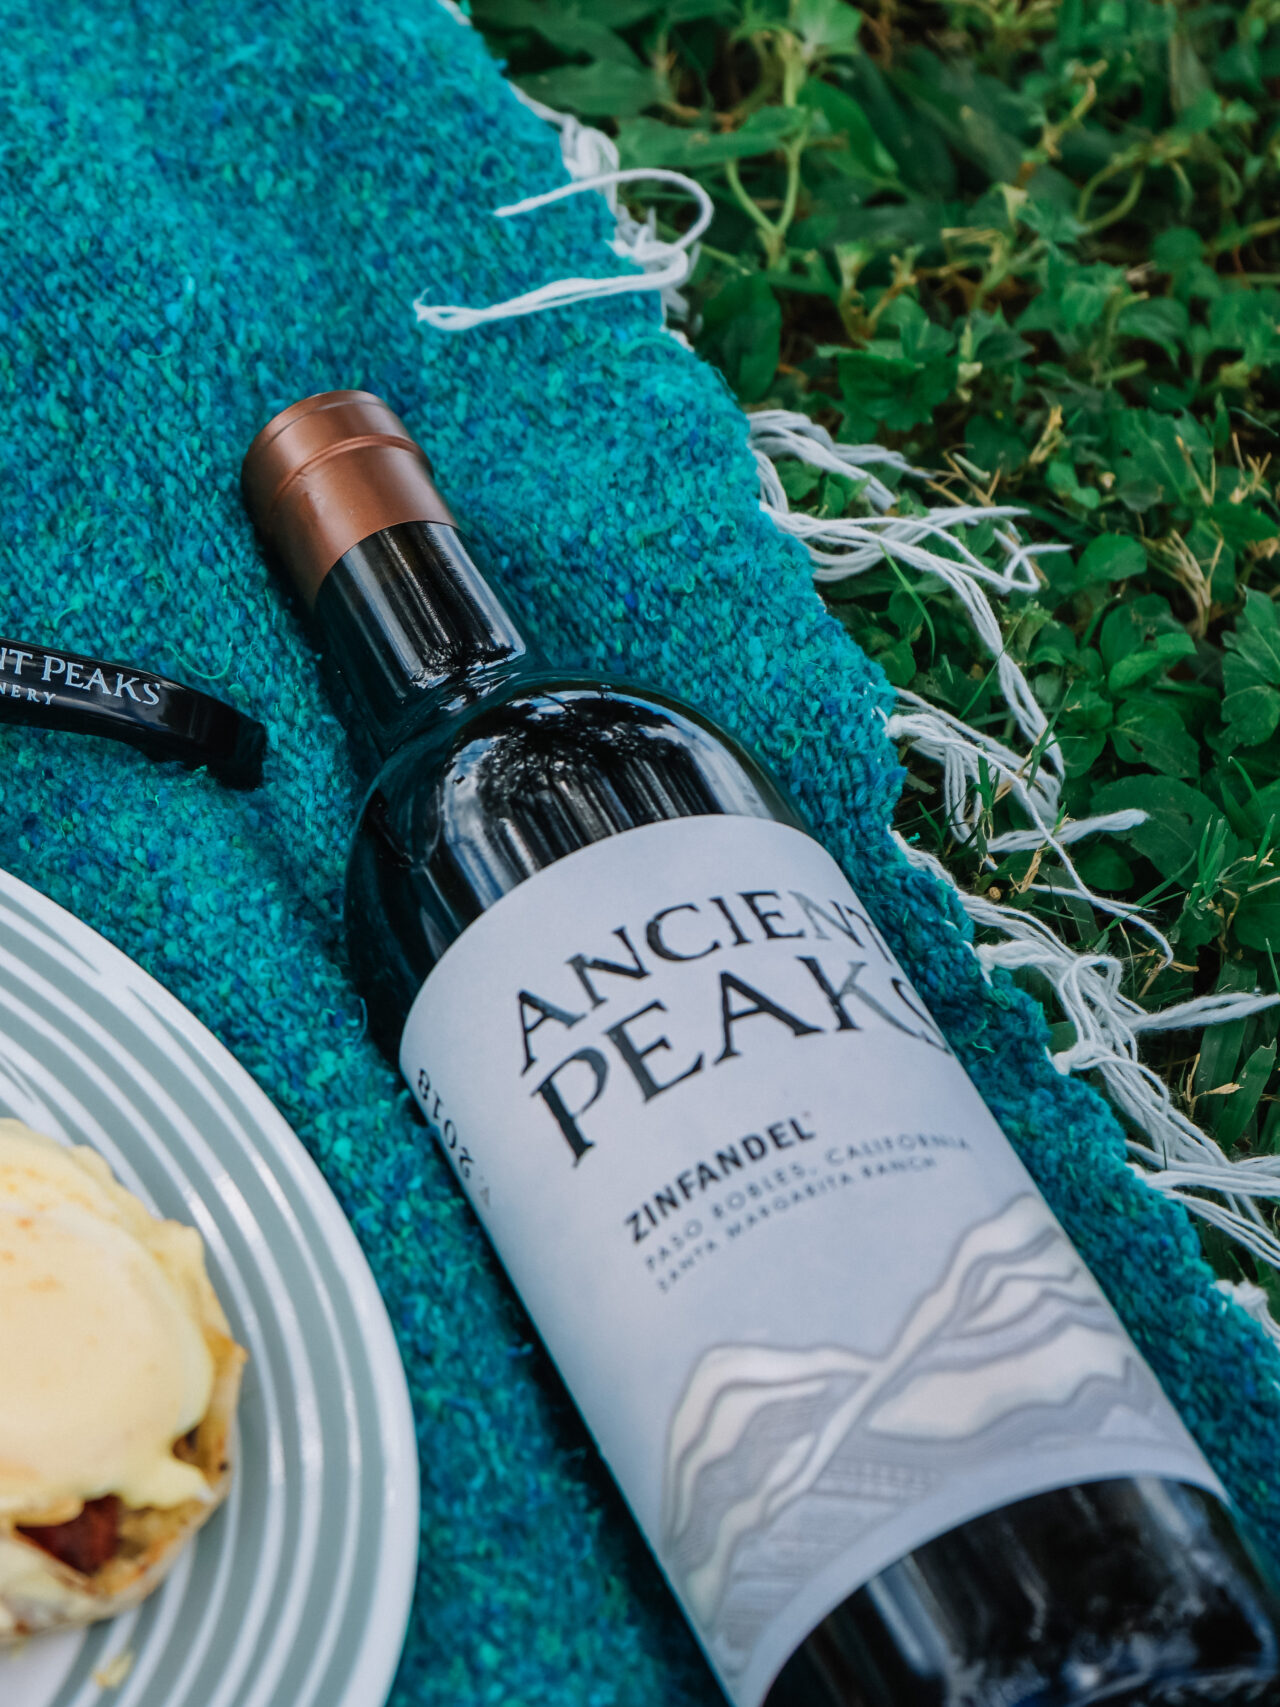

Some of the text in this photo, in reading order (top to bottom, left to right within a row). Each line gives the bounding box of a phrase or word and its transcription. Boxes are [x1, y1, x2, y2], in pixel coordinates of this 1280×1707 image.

[41, 654, 161, 705] PEAKS
[625, 1115, 816, 1244] ZINFANDEL
[646, 1133, 970, 1271] PASO ROBLES, CALIFORNIA
[658, 1156, 938, 1293] SANTA MARGARITA RANCH
